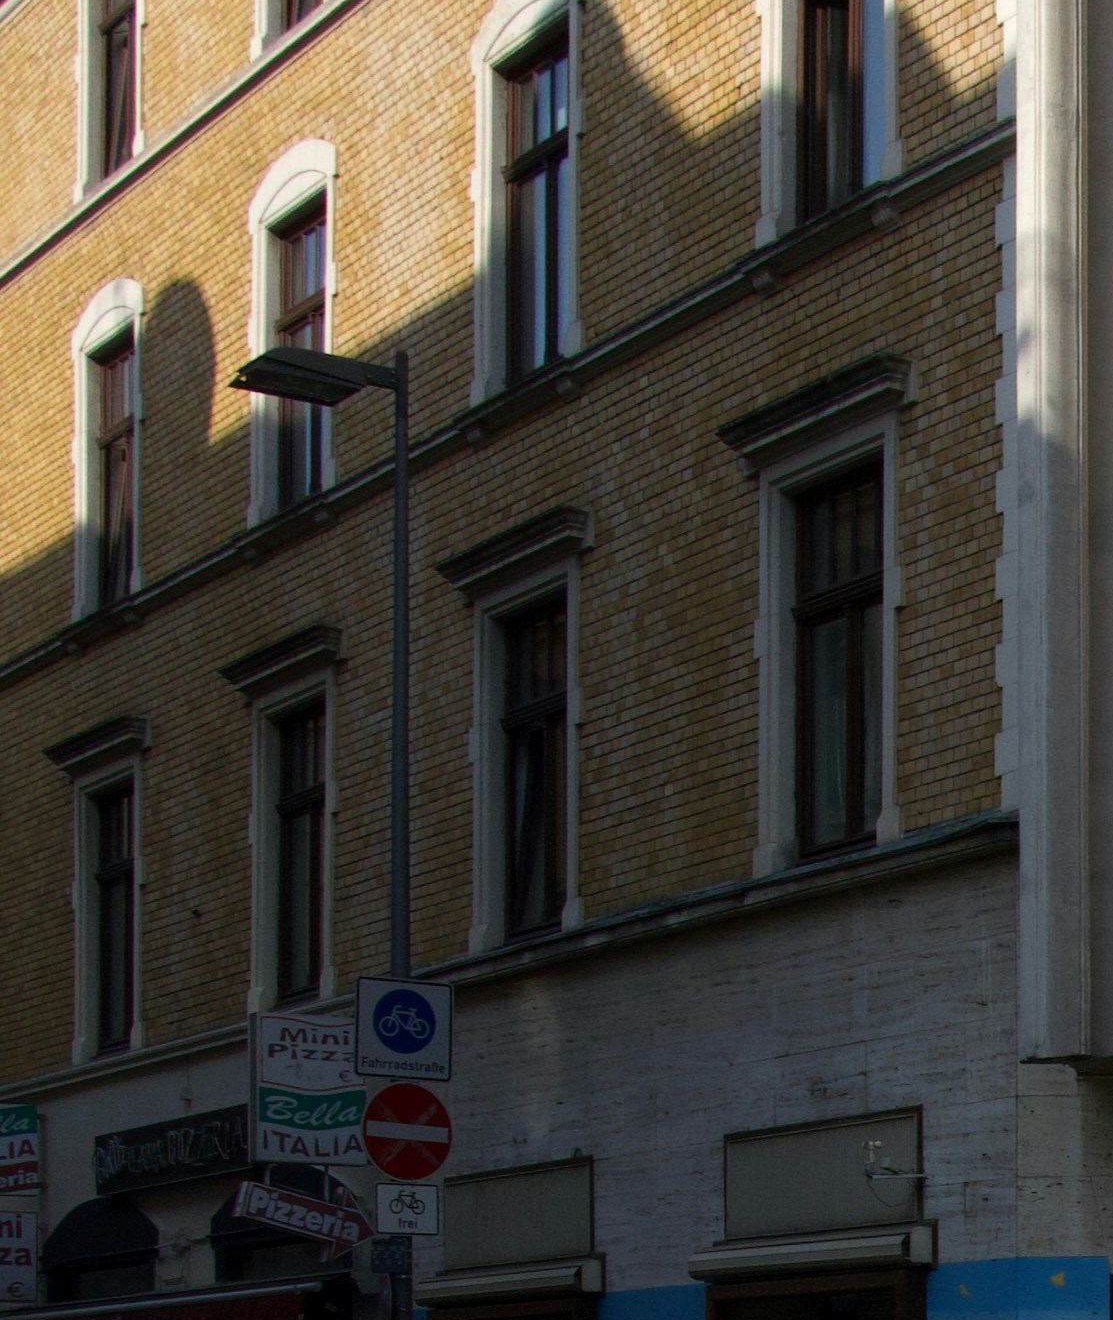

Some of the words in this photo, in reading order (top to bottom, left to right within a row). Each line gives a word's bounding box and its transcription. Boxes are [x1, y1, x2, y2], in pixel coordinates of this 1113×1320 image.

[280, 1027, 350, 1046] Mini
[361, 1056, 445, 1074] Fahrradstraße
[265, 1095, 362, 1127] Bella
[263, 1129, 363, 1158] ITALIA
[248, 1185, 361, 1244] Pizzeria
[398, 1217, 418, 1230] frei
